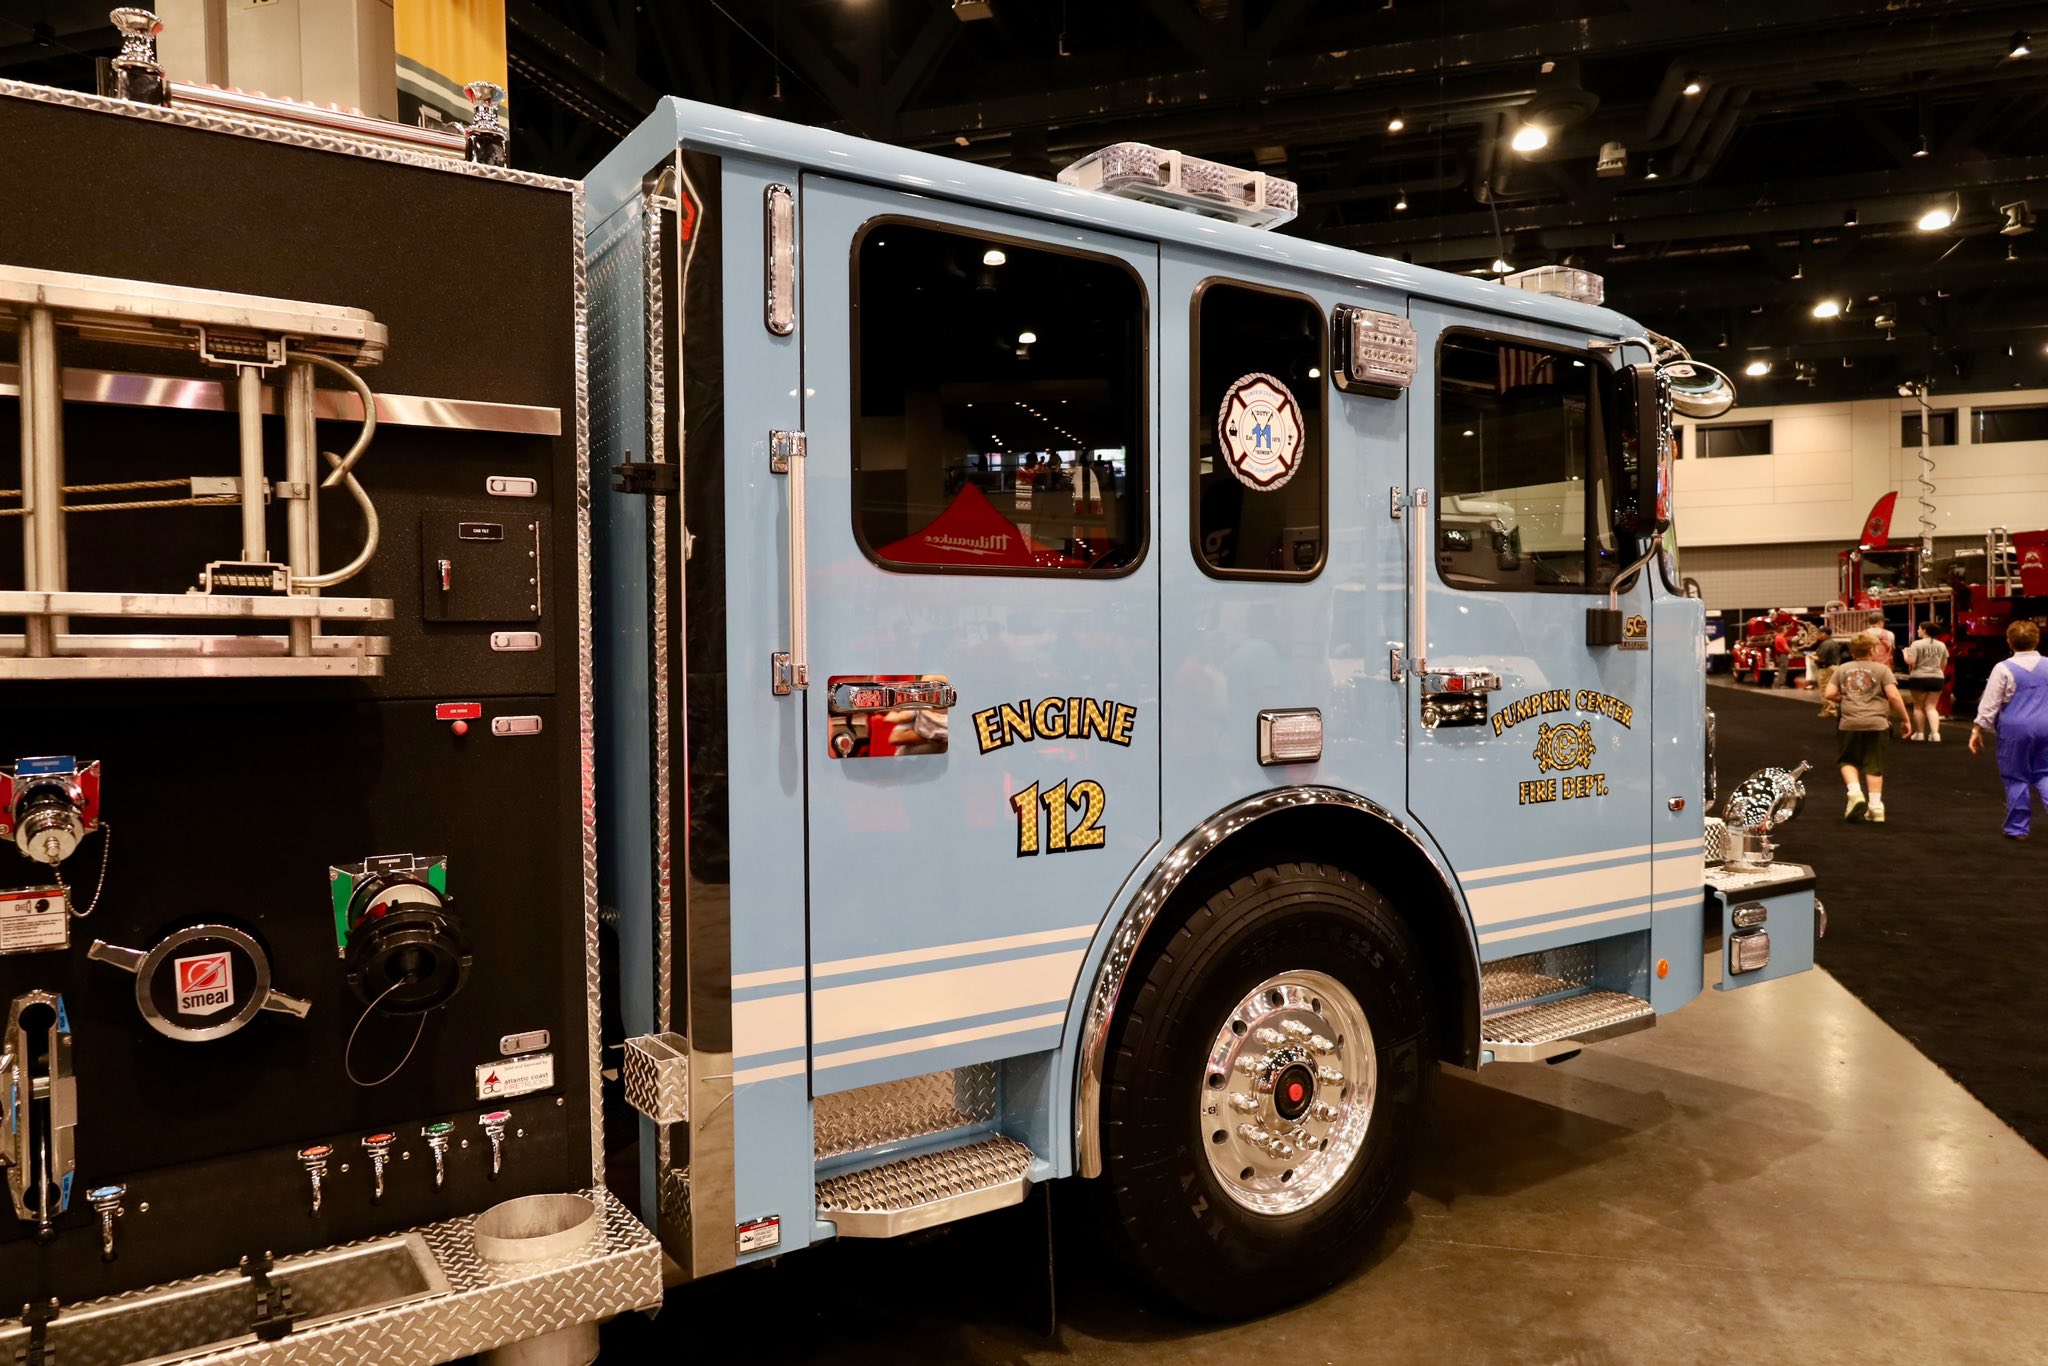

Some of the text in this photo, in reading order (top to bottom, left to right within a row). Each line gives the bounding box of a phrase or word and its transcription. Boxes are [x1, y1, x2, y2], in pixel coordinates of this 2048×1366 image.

[972, 696, 1137, 755] ENGINE
[1491, 689, 1633, 737] PUMPKIN CENTER
[1519, 773, 1609, 805] FIRE DEPT.
[1009, 778, 1105, 858] 112
[182, 989, 229, 1009] smeal
[504, 1076, 529, 1084] atlantic
